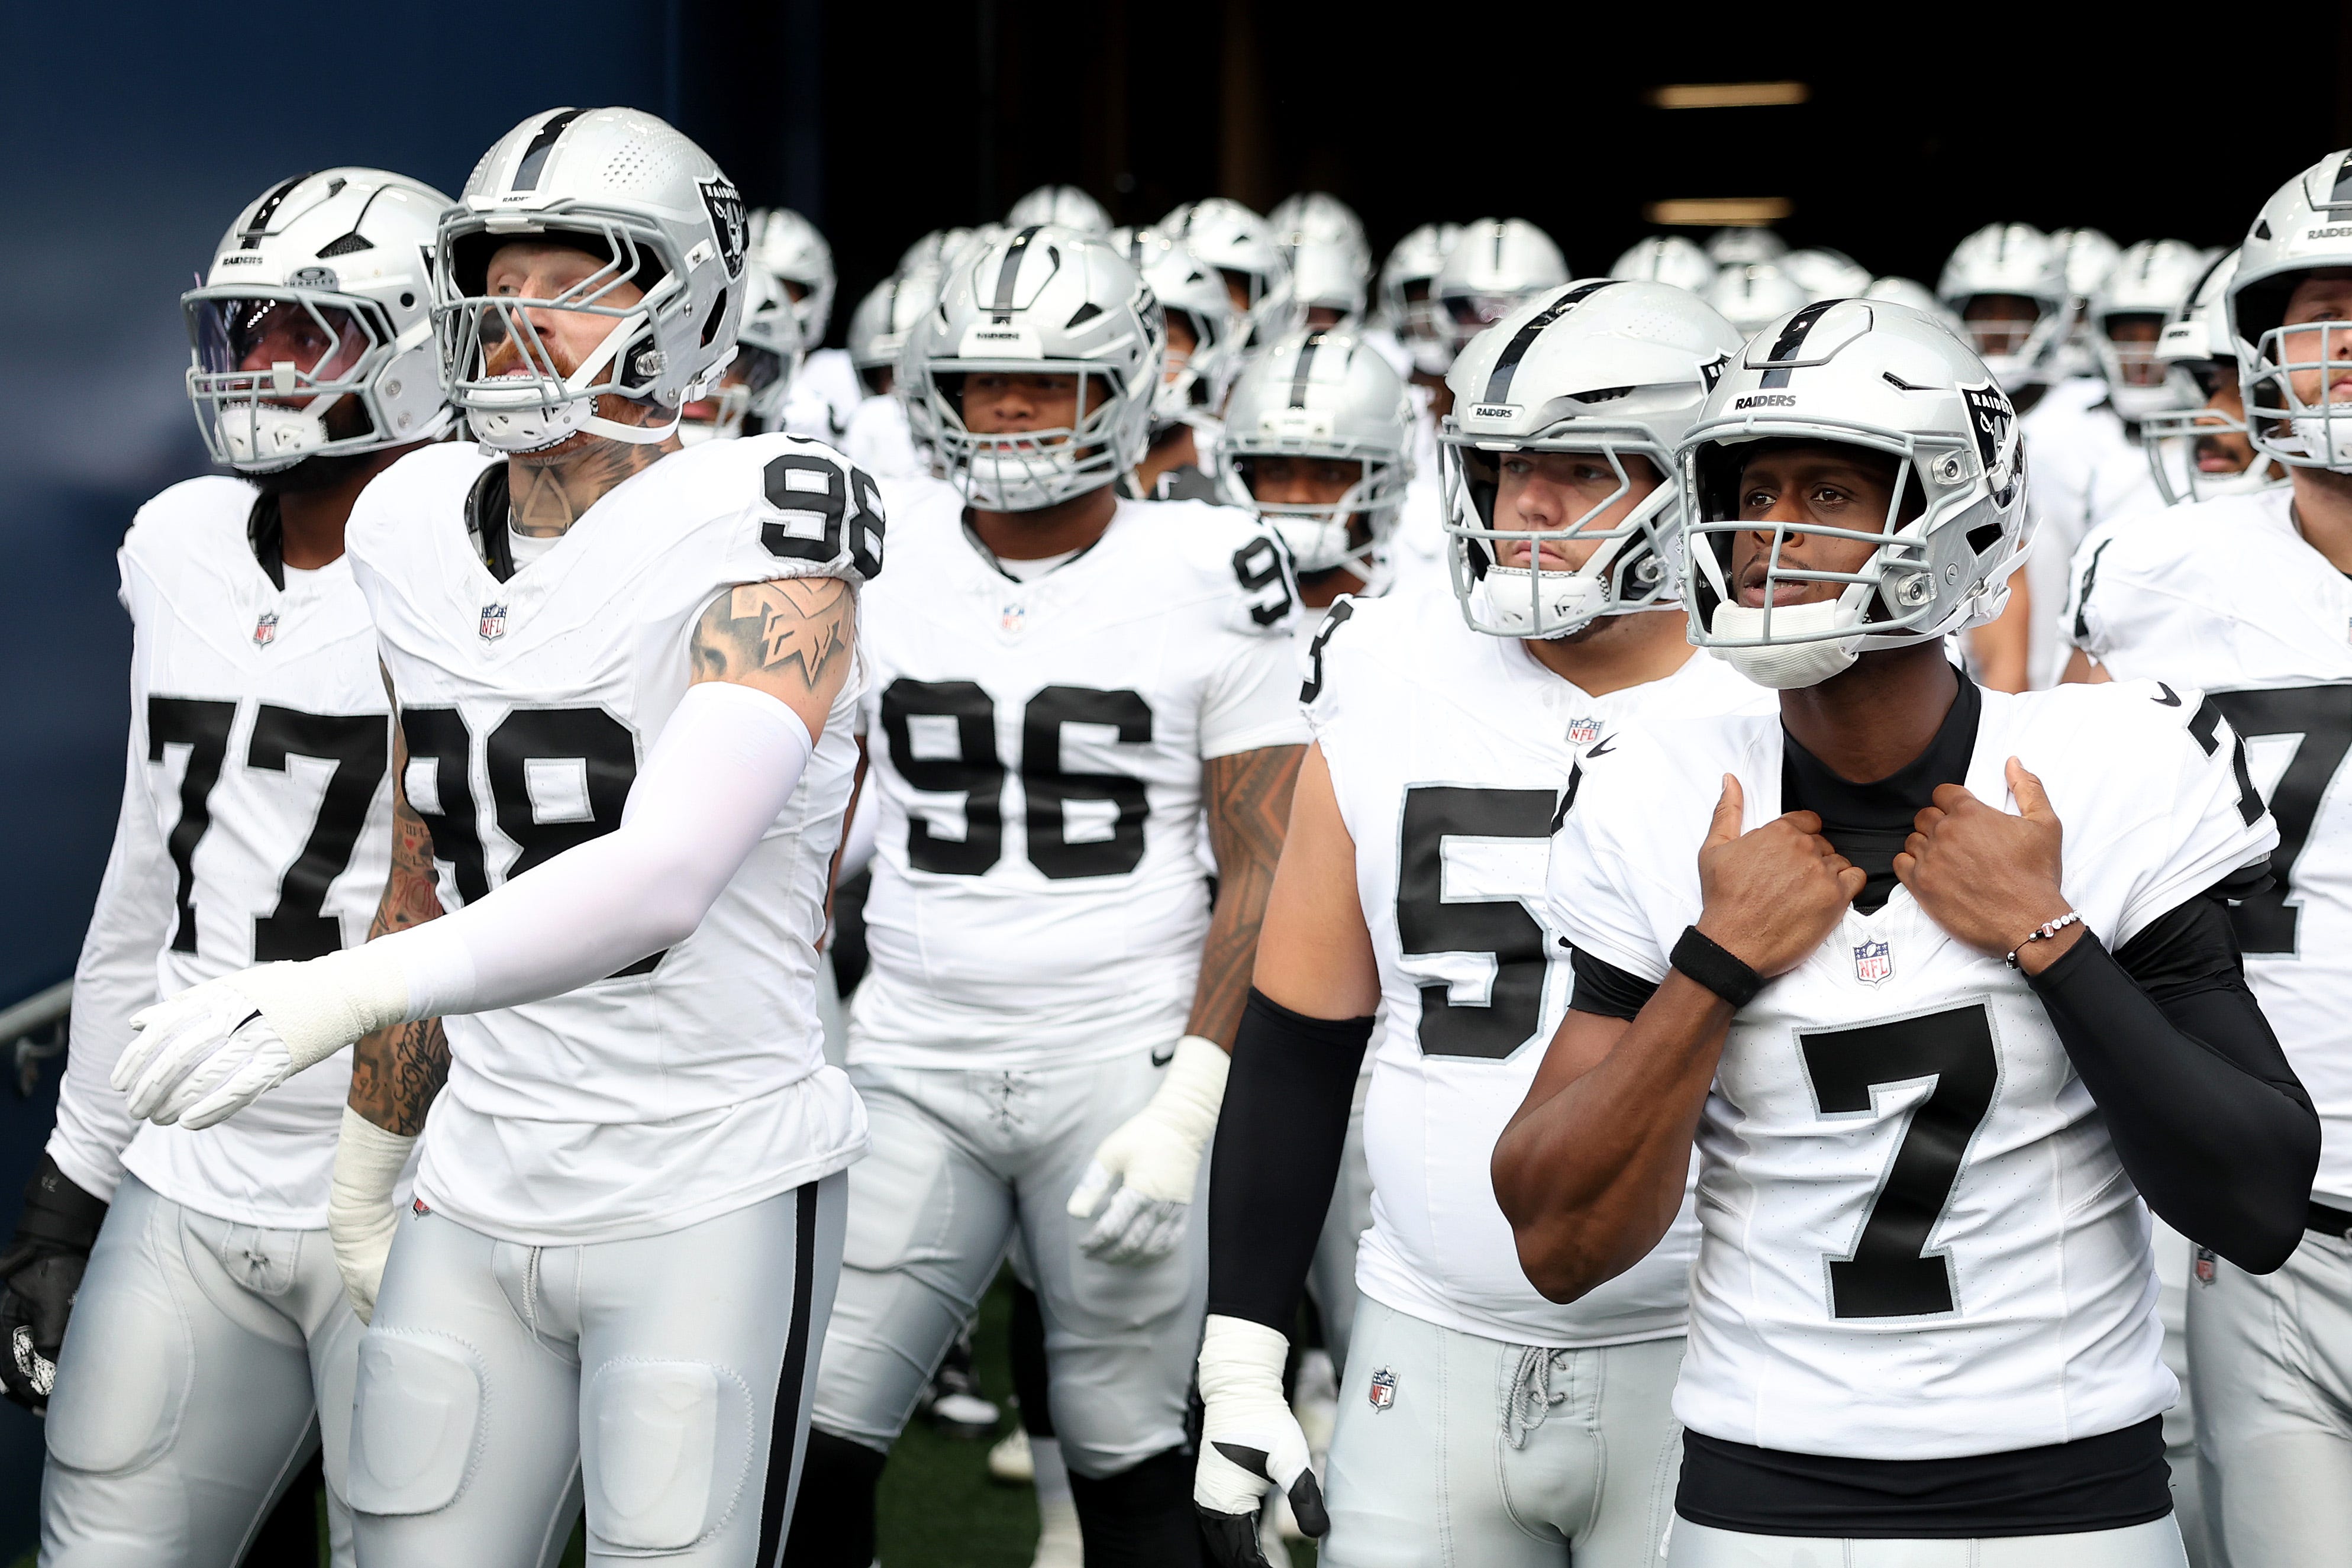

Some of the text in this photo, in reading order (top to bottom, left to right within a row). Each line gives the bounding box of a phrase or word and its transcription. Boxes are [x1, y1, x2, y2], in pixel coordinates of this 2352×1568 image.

[1476, 408, 1513, 418] RAIDERS
[1735, 395, 1796, 410] RAIDERS
[1232, 535, 1299, 627] 9
[482, 618, 501, 636] NFL
[1570, 728, 1594, 741] NFL
[880, 677, 1153, 880] 96
[147, 696, 390, 963] 77
[1396, 786, 1550, 1062] 5
[1859, 957, 1889, 979] NFL
[1795, 999, 2001, 1321] 7
